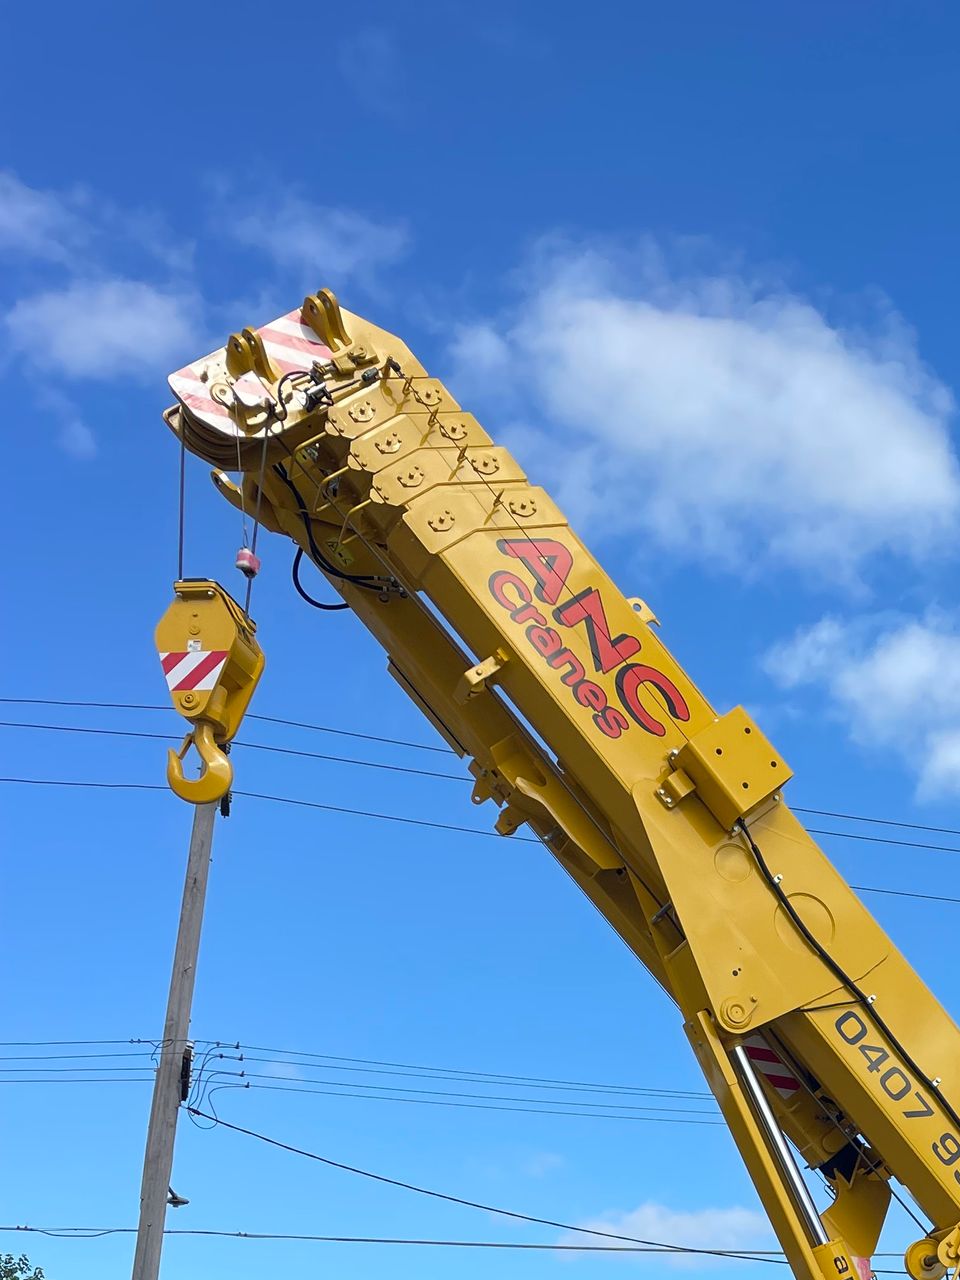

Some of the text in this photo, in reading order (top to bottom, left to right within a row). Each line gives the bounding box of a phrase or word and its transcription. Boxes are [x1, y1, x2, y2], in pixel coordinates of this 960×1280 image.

[488, 570, 629, 738] Cranes
[496, 538, 690, 737] ANC
[834, 1010, 935, 1120] 0407
